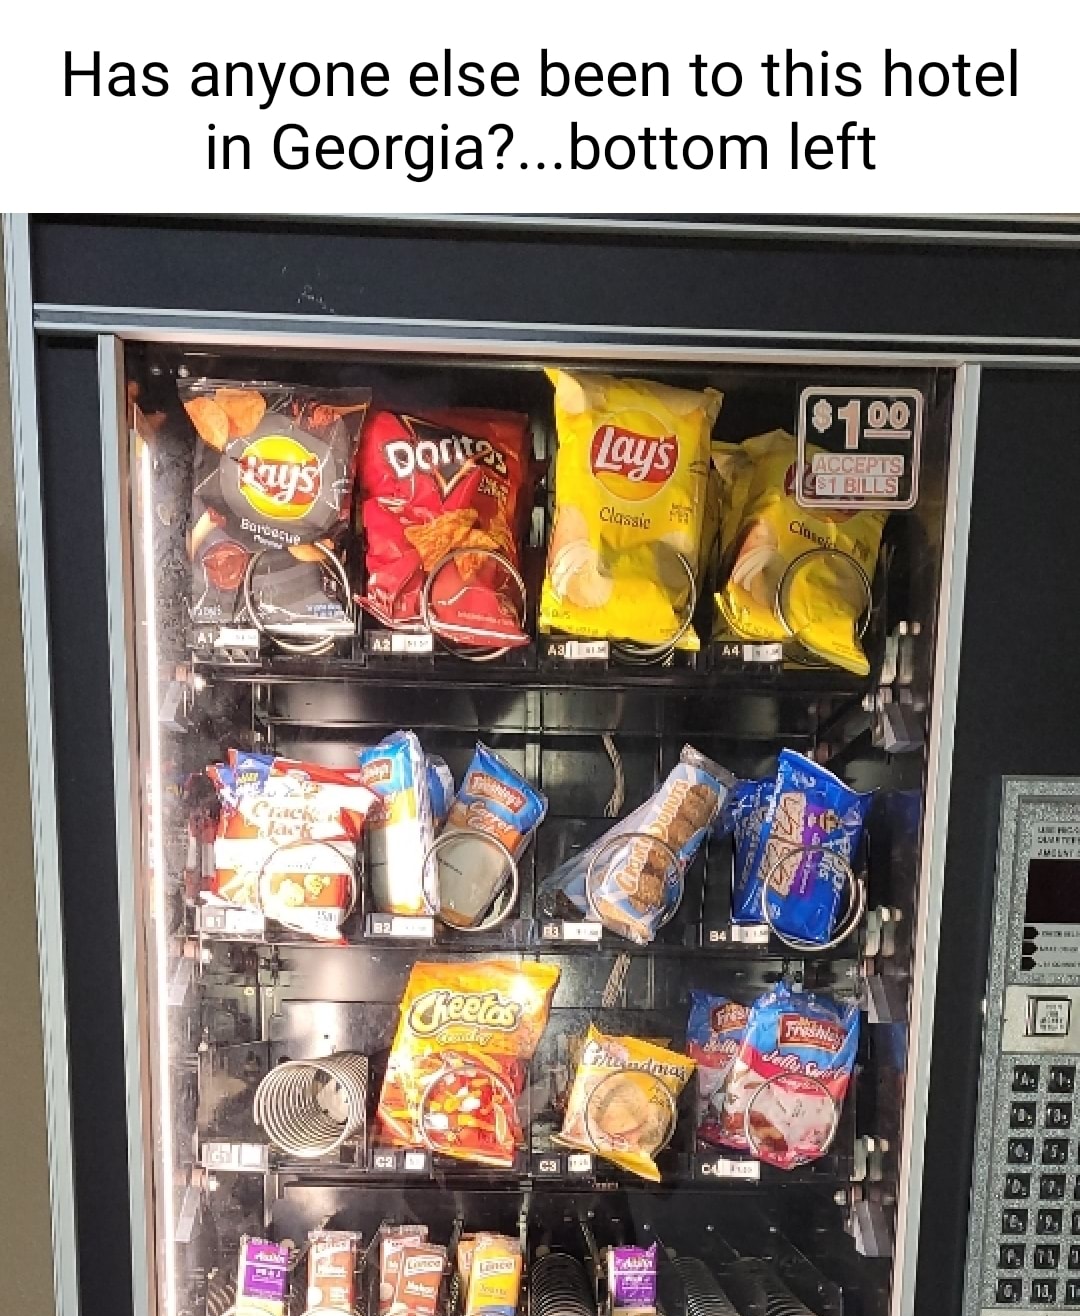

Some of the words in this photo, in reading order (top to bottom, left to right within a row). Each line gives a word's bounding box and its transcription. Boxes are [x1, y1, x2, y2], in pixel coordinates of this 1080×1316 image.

[384, 434, 508, 478] Doritos
[595, 426, 676, 481] Lay's
[813, 455, 903, 475] ACCEPTS
[816, 477, 838, 495] $1
[843, 476, 898, 495] BILLS
[599, 505, 652, 530] Classic
[547, 644, 566, 657] A3
[720, 644, 741, 657] A4
[708, 930, 728, 943] B4
[408, 990, 523, 1035] Cheetos
[478, 1258, 514, 1273] Lance
